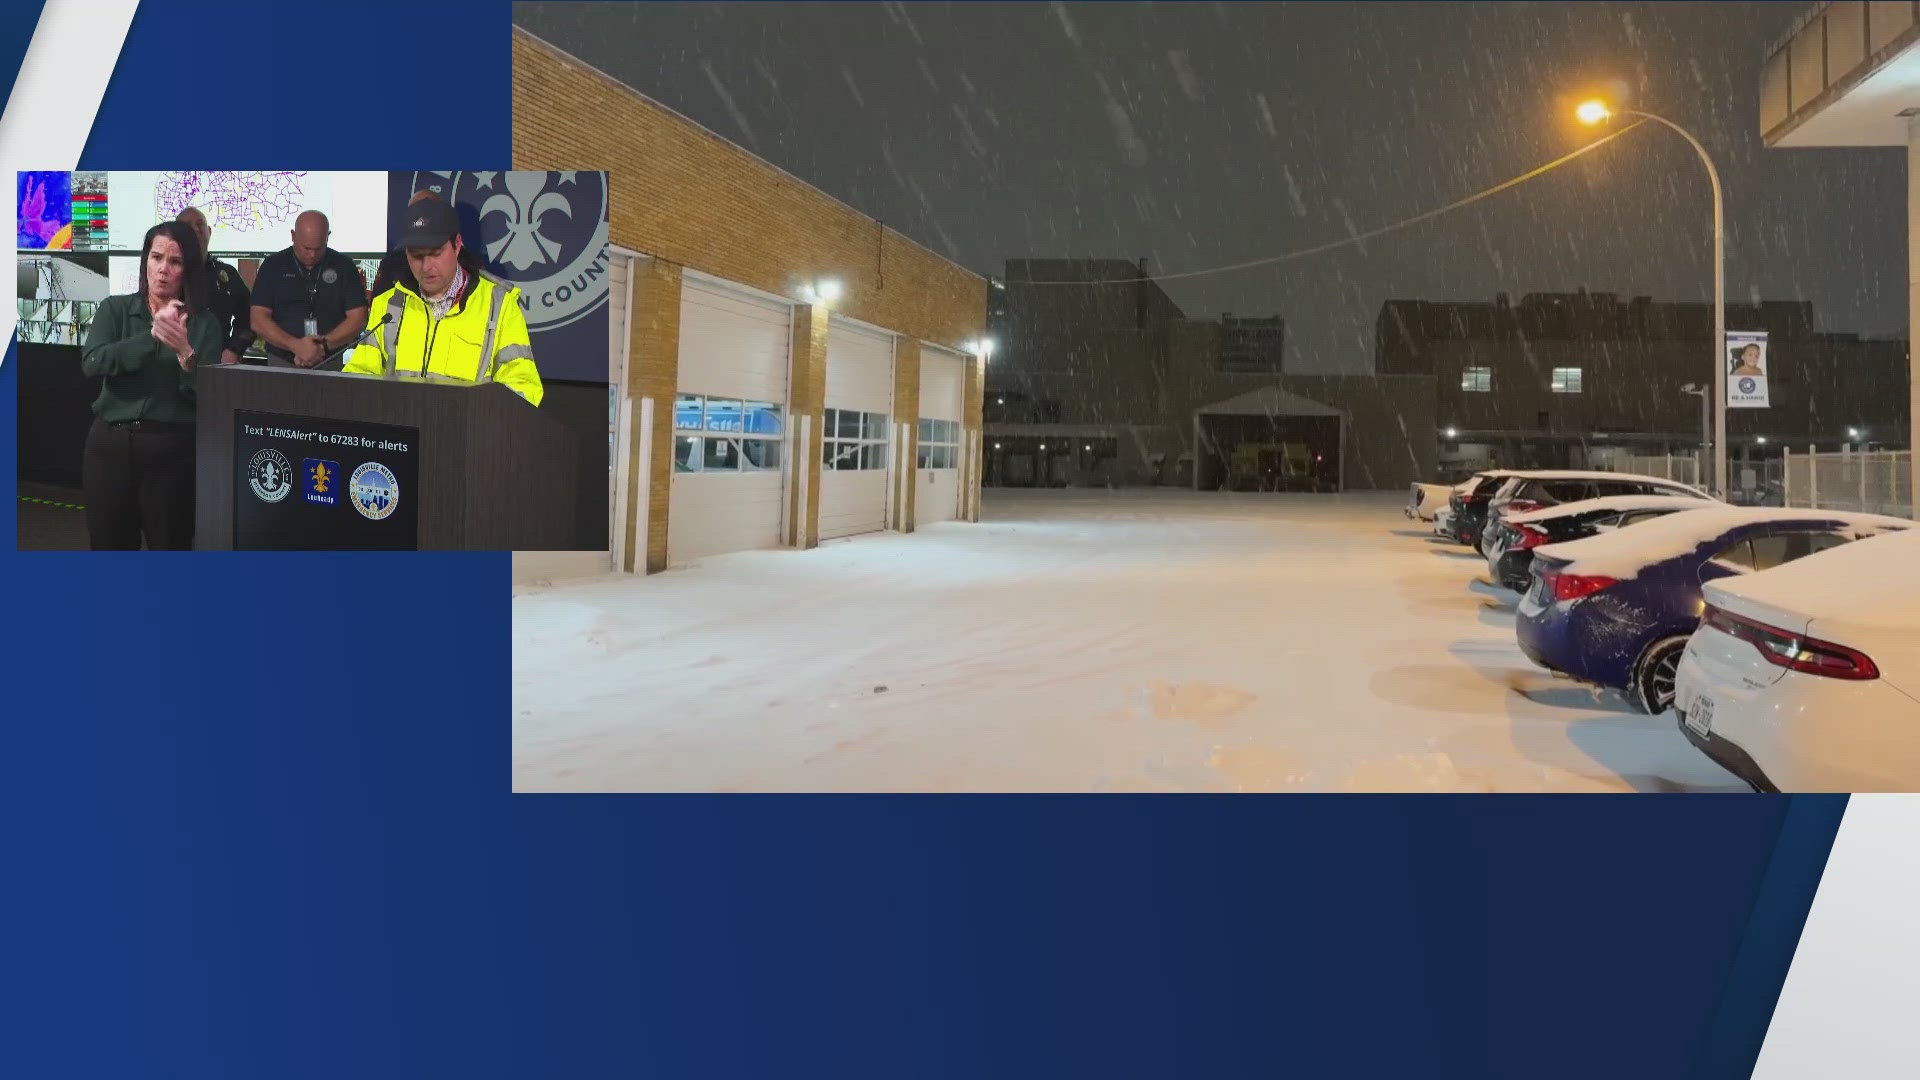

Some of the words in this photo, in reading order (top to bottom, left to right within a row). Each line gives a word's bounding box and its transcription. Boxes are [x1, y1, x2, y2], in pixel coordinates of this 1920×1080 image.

[244, 424, 264, 436] Text
[318, 433, 329, 443] to
[331, 434, 359, 446] 67283
[361, 437, 376, 448] for
[378, 440, 408, 452] alerts
[251, 450, 289, 471] LOUISVILLE
[353, 463, 379, 480] LOUISVILLE
[380, 466, 396, 485] METRO
